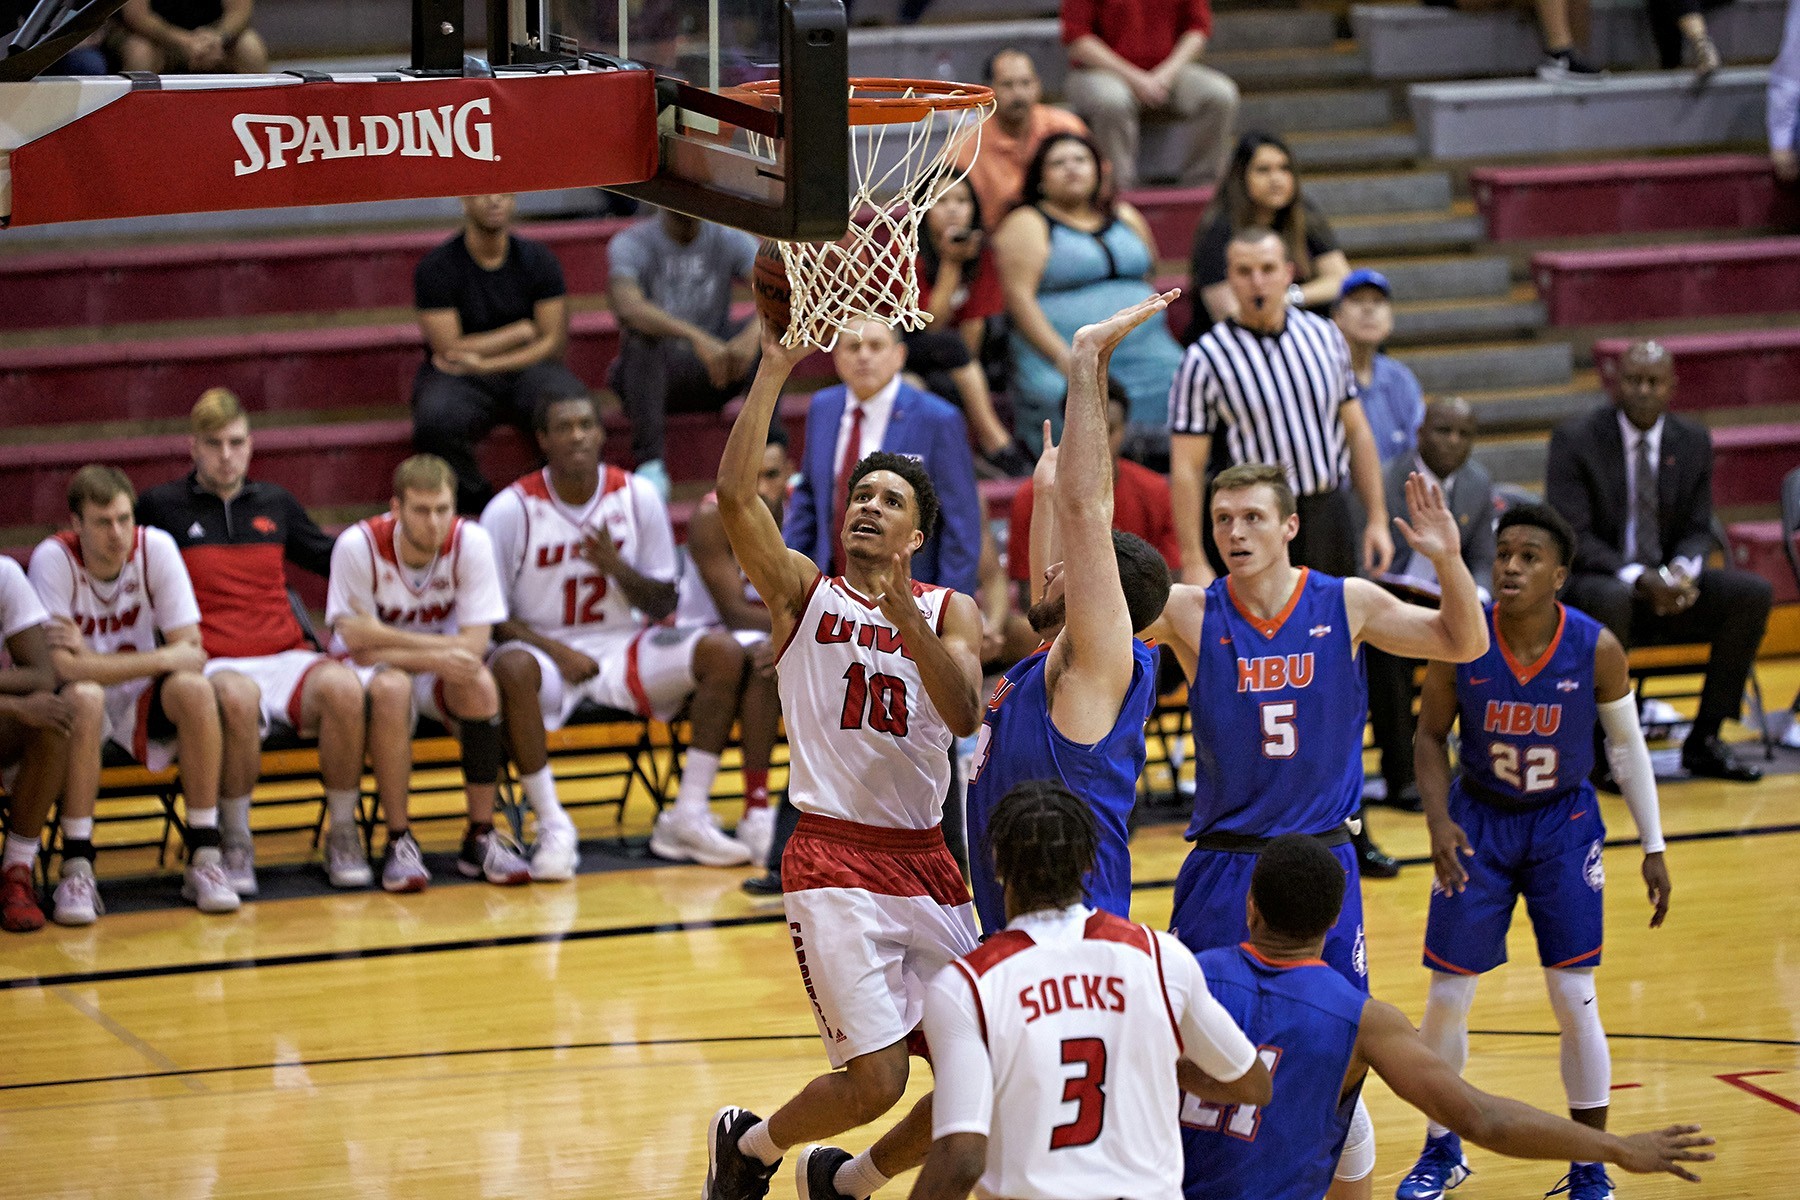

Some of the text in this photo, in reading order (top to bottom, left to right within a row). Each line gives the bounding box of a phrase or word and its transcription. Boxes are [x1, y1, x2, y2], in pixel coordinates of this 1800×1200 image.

[232, 97, 494, 177] SPALDING
[563, 573, 608, 626] 12
[1236, 651, 1315, 693] HBU
[840, 661, 909, 738] 10
[1483, 699, 1563, 737] HBU
[1259, 700, 1299, 760] 5
[1488, 741, 1559, 794] 22
[1018, 974, 1126, 1024] SOCKS
[1049, 1036, 1108, 1153] 3
